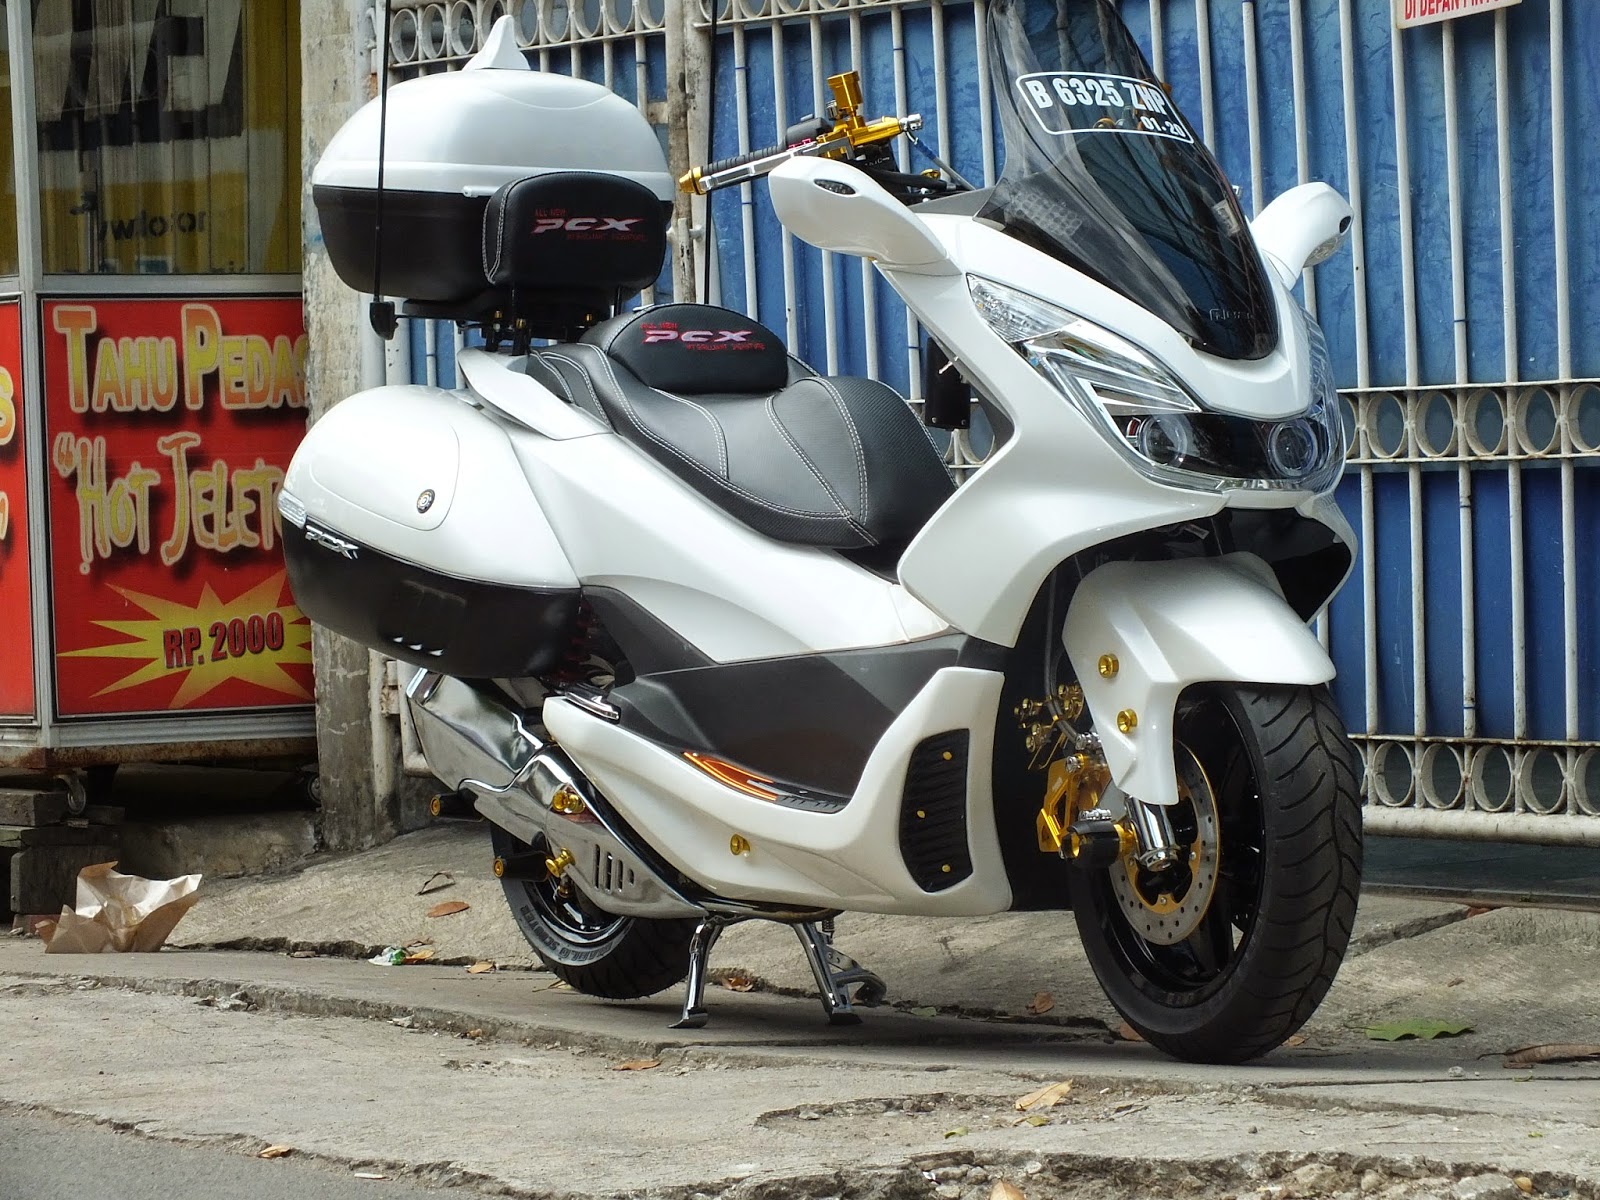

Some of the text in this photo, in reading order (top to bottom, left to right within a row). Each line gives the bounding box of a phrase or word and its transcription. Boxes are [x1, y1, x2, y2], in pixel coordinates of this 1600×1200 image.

[1025, 80, 1053, 109] B
[1053, 78, 1125, 108] 6325
[530, 217, 645, 235] PCX
[642, 329, 752, 344] PCX
[158, 431, 283, 566] JELET
[208, 611, 284, 662] 2000
